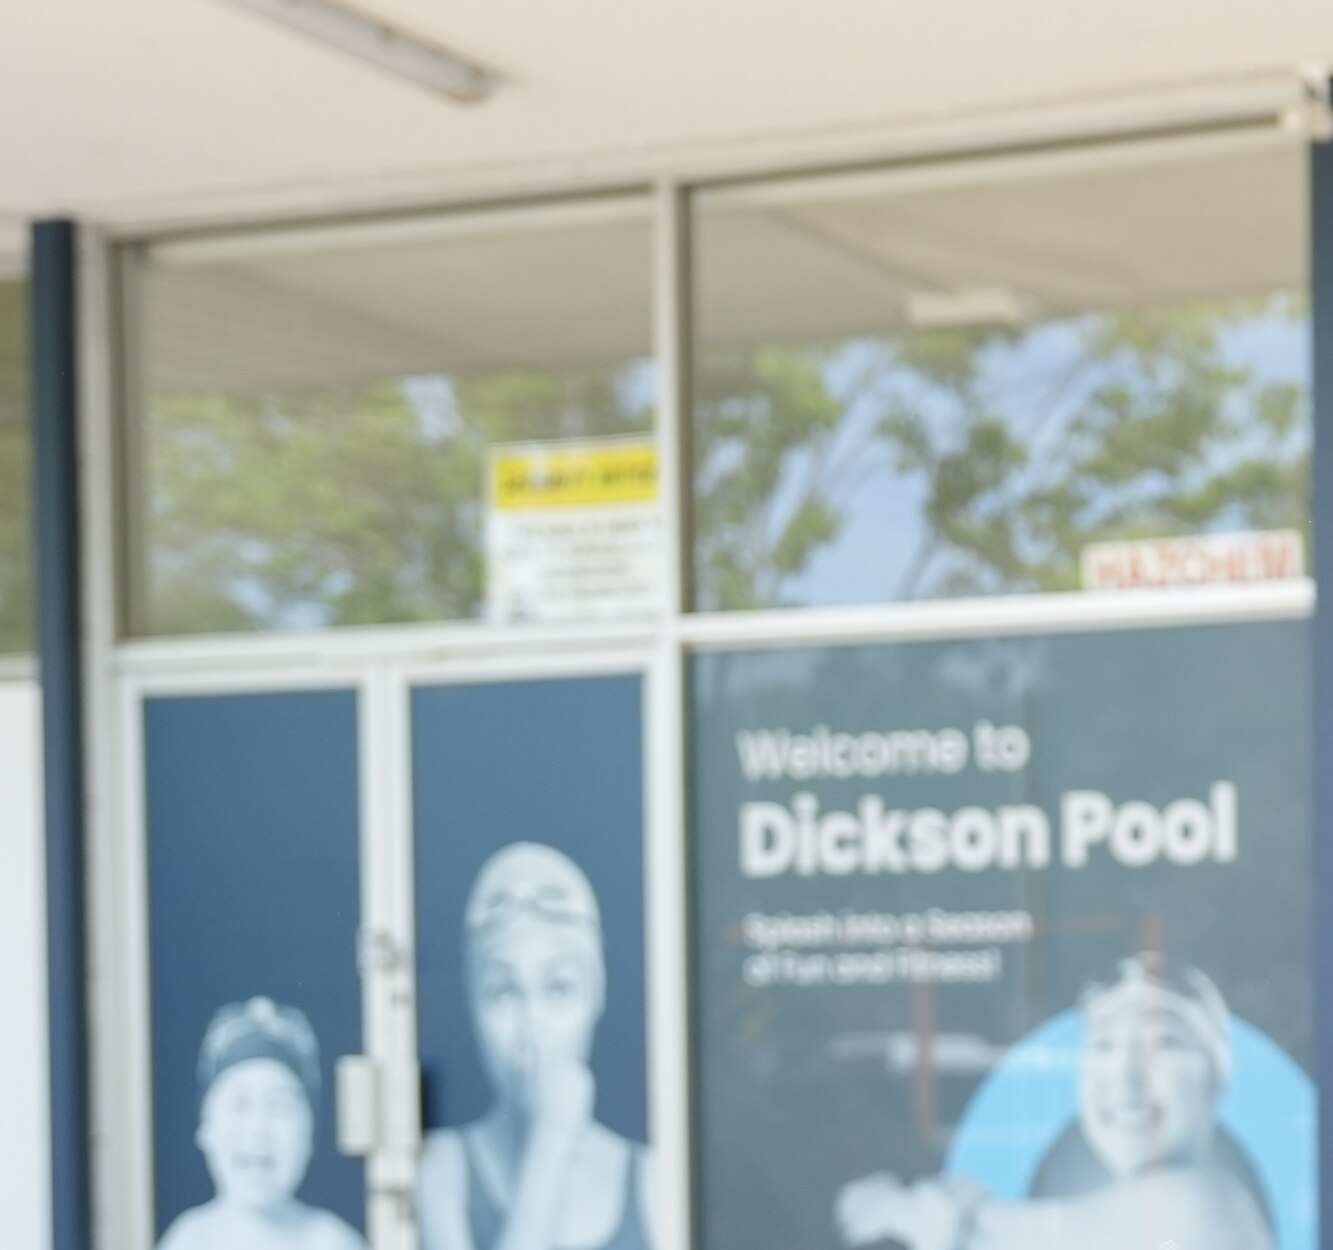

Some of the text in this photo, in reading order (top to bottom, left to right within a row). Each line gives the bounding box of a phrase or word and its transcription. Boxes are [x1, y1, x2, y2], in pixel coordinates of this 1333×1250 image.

[740, 722, 1028, 779] Welcome to
[741, 783, 1236, 875] Dickson Pool
